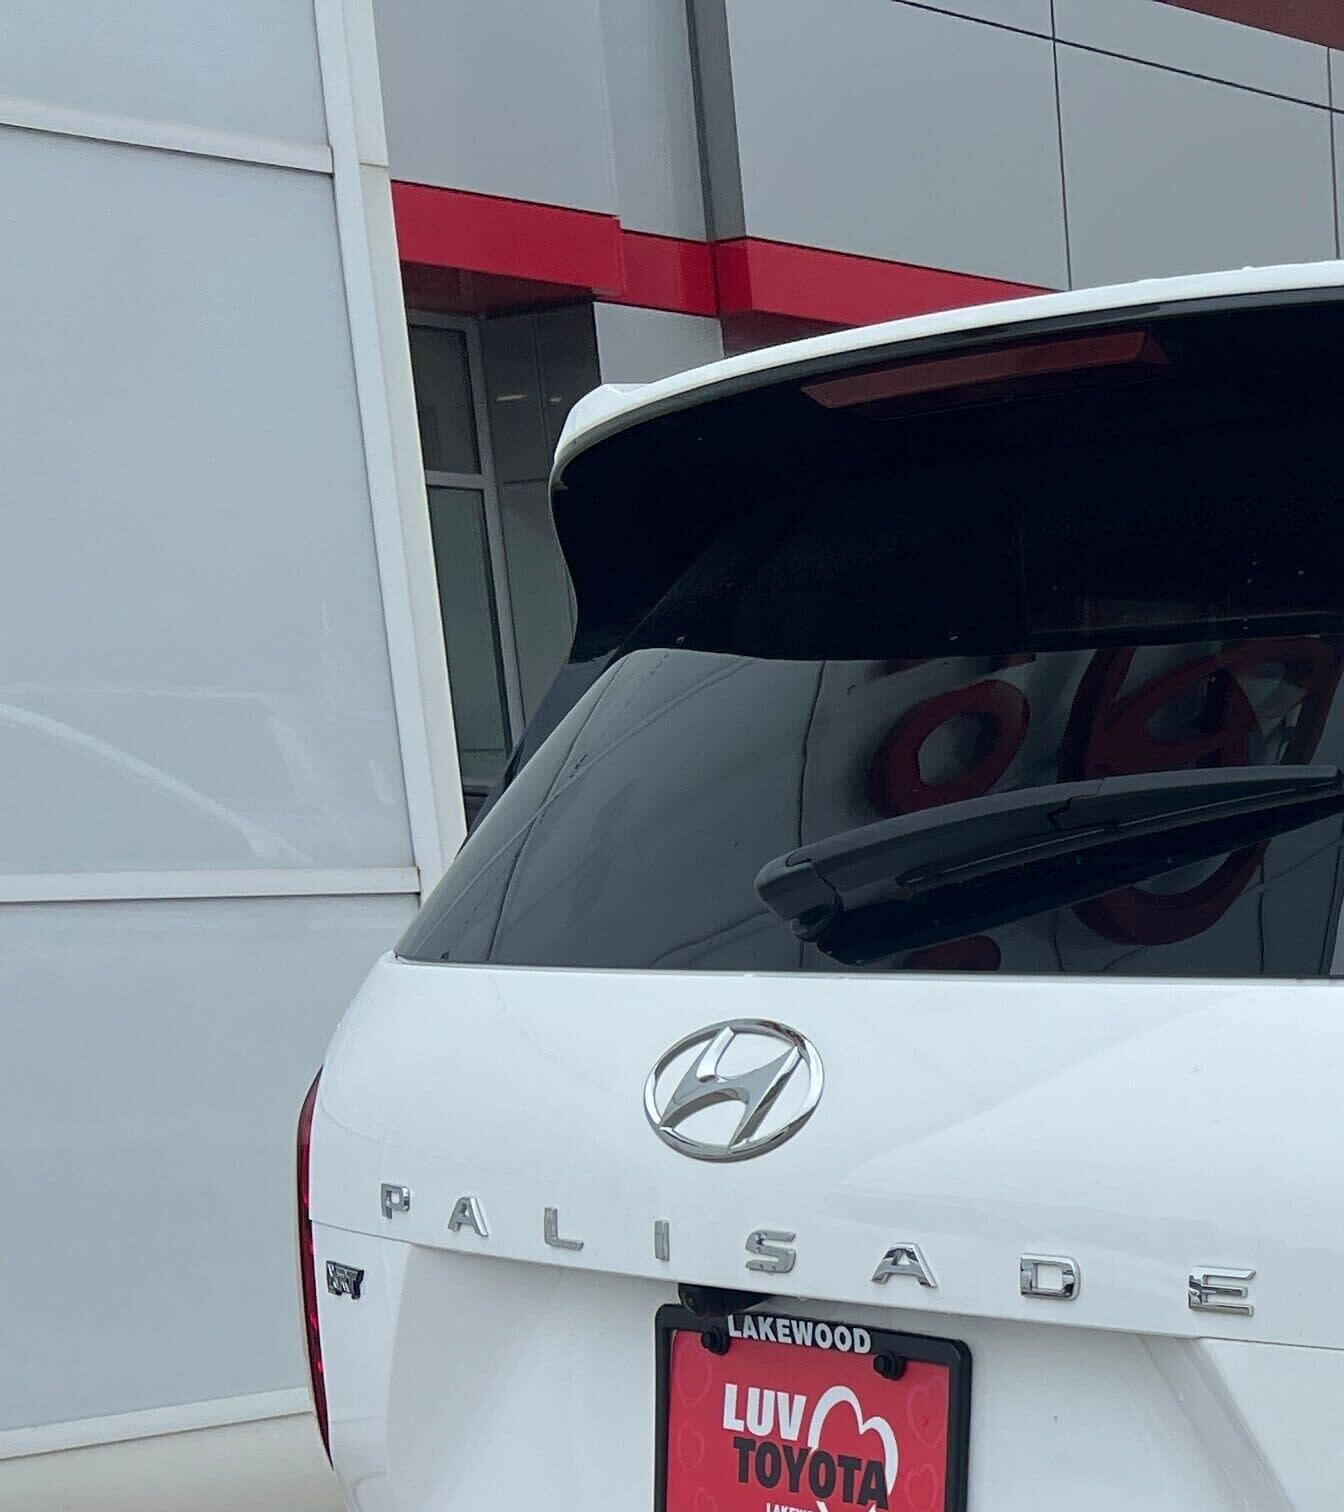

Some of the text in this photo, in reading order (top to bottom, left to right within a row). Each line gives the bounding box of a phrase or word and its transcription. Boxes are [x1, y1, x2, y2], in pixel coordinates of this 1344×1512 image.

[380, 1183, 1255, 1318] PALISADE
[727, 1314, 872, 1354] LAKEWOOD
[723, 1383, 807, 1441] LUV
[733, 1436, 889, 1511] TOYOTA
